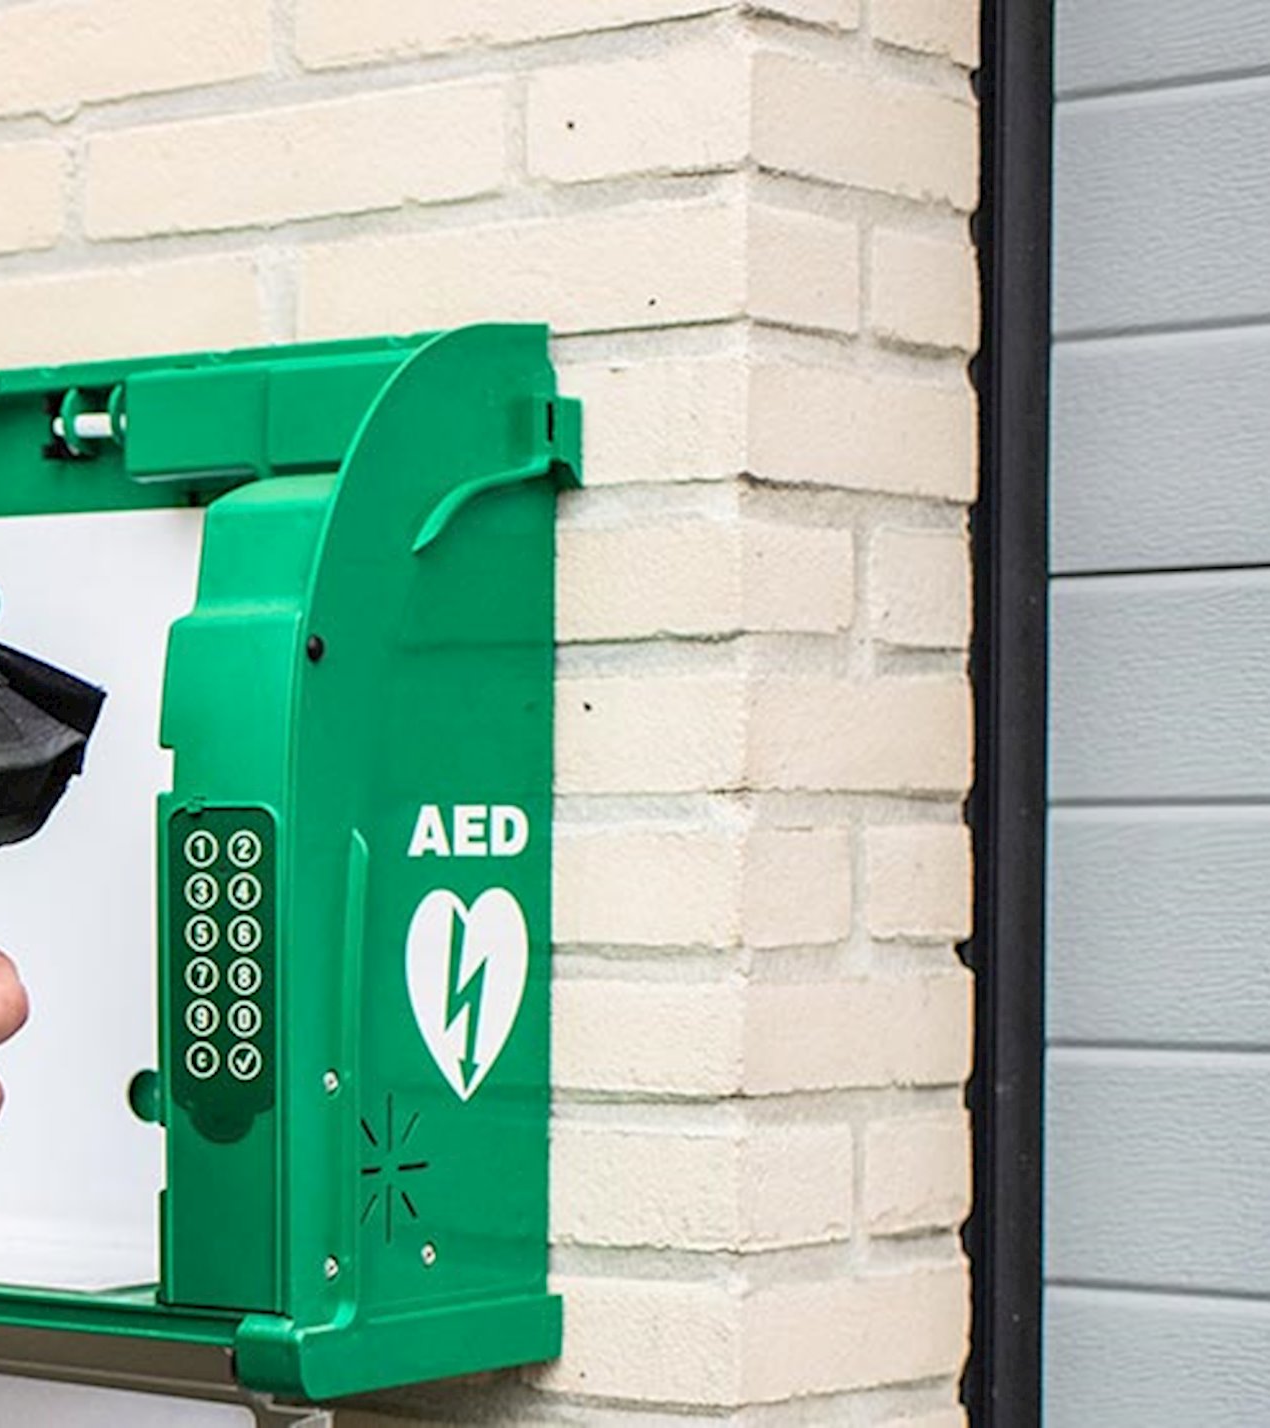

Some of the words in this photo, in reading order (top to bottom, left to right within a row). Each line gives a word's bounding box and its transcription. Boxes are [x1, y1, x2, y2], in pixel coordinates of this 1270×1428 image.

[408, 804, 529, 857] AED
[194, 838, 206, 859] 1
[237, 837, 251, 860] 2
[195, 880, 209, 903] 3
[235, 880, 251, 902] 4
[195, 922, 209, 945] 5
[237, 922, 252, 946] 6
[196, 964, 209, 987] 7
[237, 965, 252, 988] 8
[195, 1006, 210, 1029] 9
[237, 1007, 252, 1030] 0
